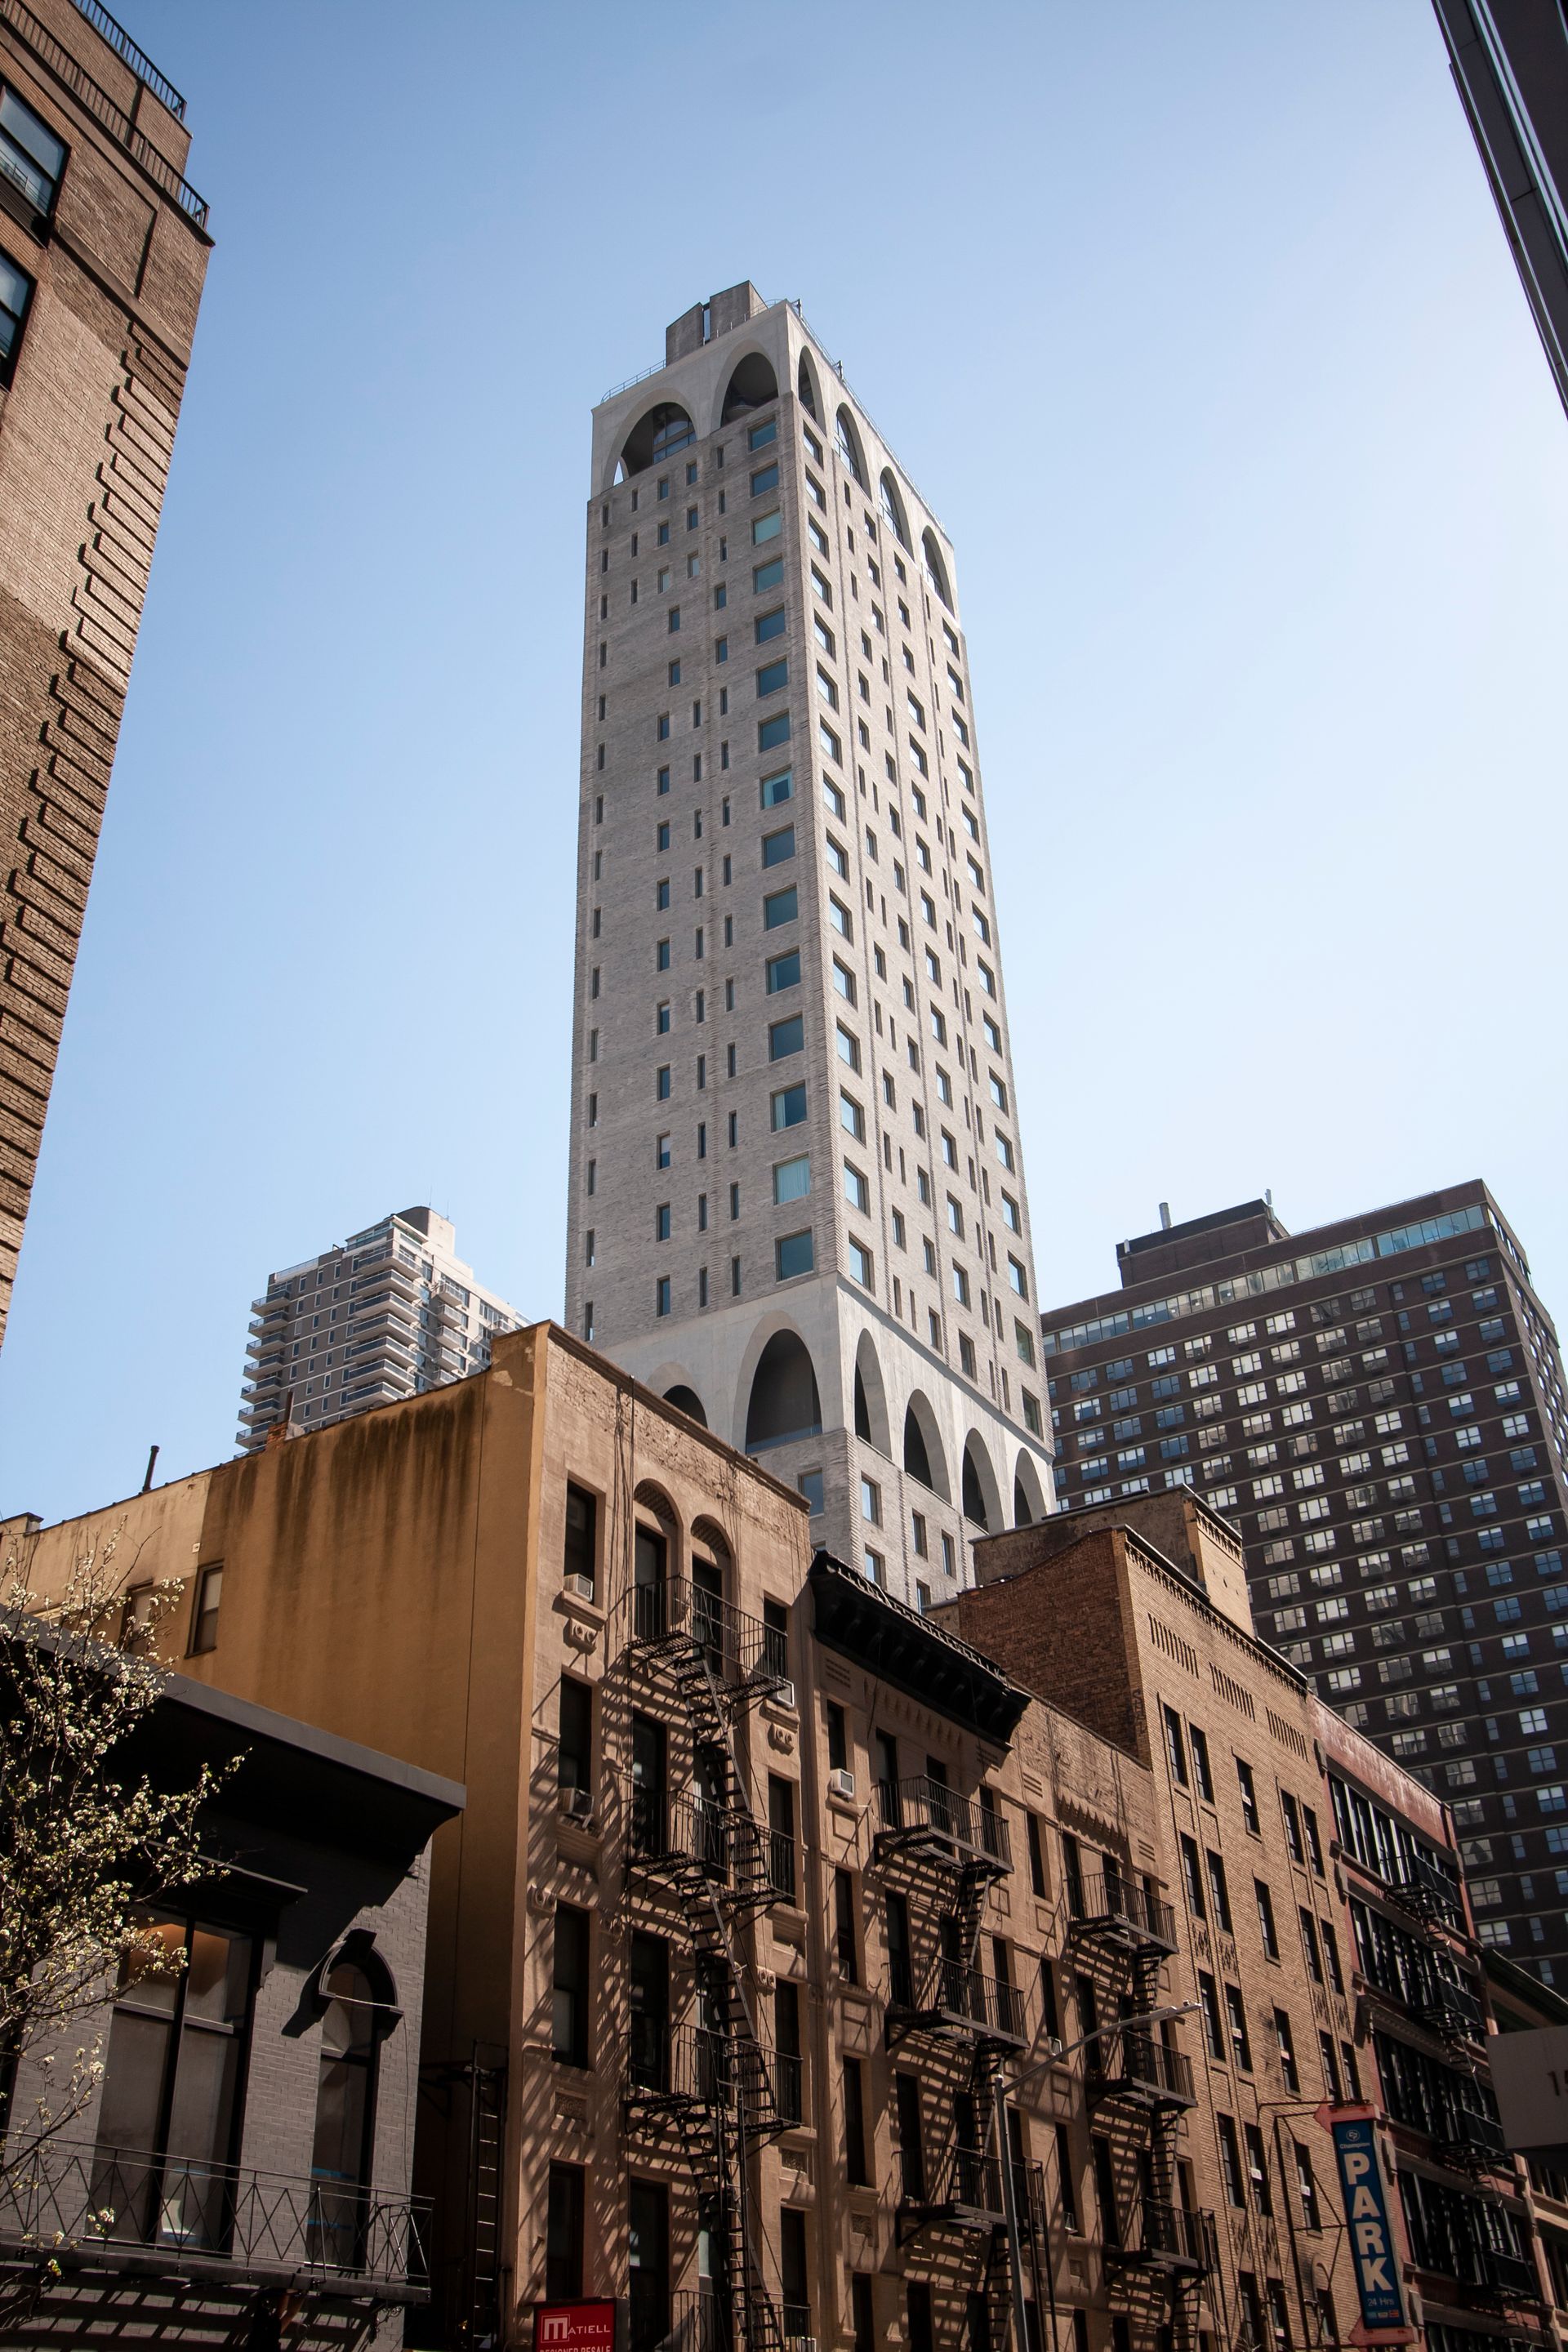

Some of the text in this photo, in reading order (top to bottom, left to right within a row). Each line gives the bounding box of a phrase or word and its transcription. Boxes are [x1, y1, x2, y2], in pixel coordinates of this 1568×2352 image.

[1343, 2152, 1393, 2292] PARK
[1367, 2297, 1377, 2307] 24
[543, 2317, 611, 2341] MATIELL
